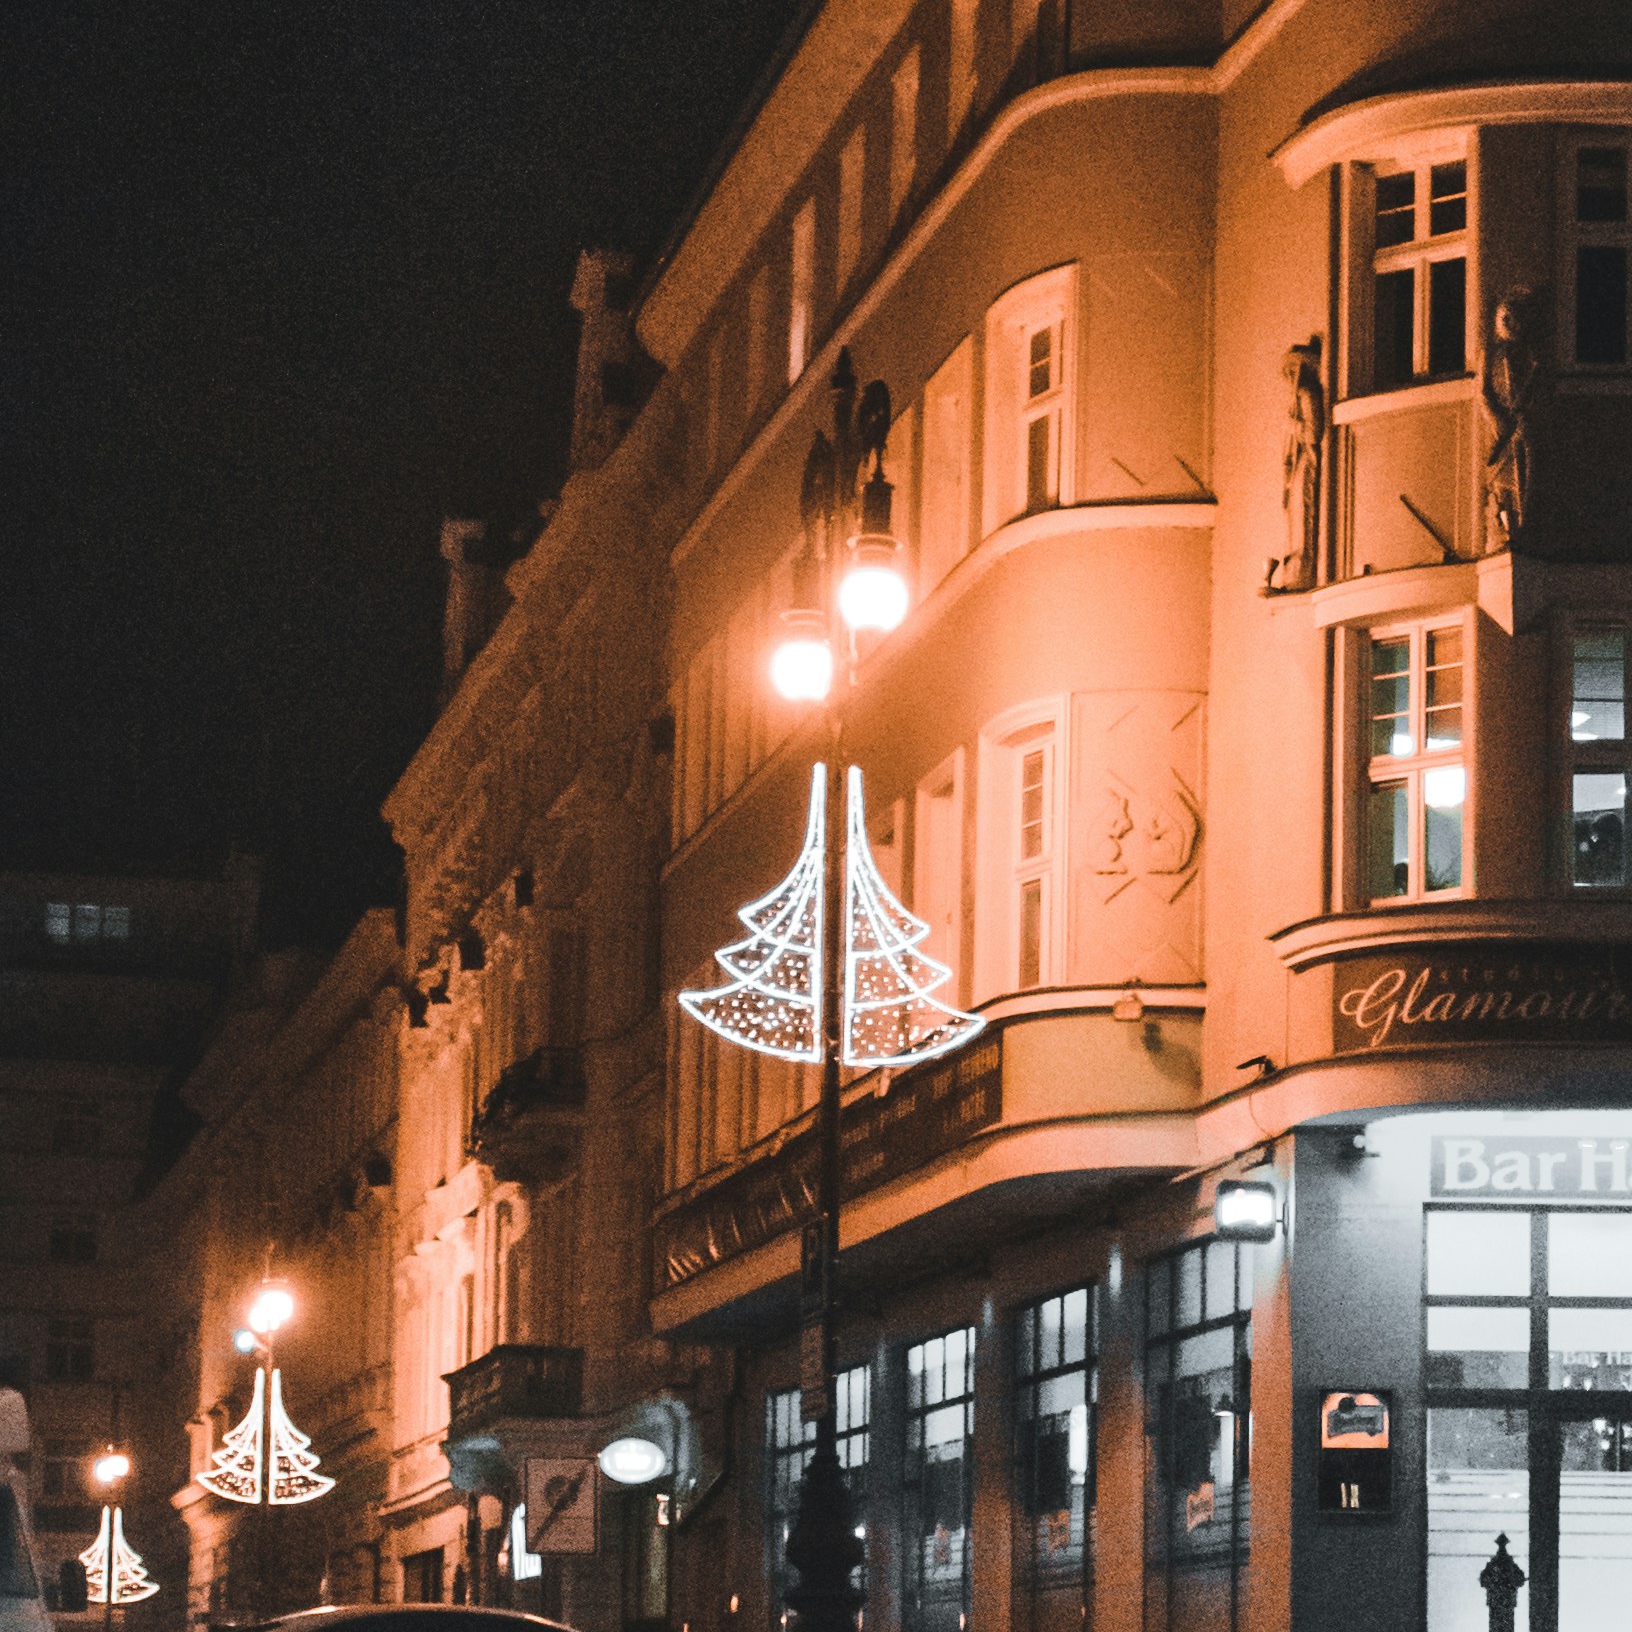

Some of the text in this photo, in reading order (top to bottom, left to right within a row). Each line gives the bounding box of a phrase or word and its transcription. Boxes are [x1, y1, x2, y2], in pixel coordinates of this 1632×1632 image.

[1338, 967, 1629, 1047] Glamour
[1442, 1138, 1566, 1191] Bar
[1562, 1350, 1600, 1365] Bar
